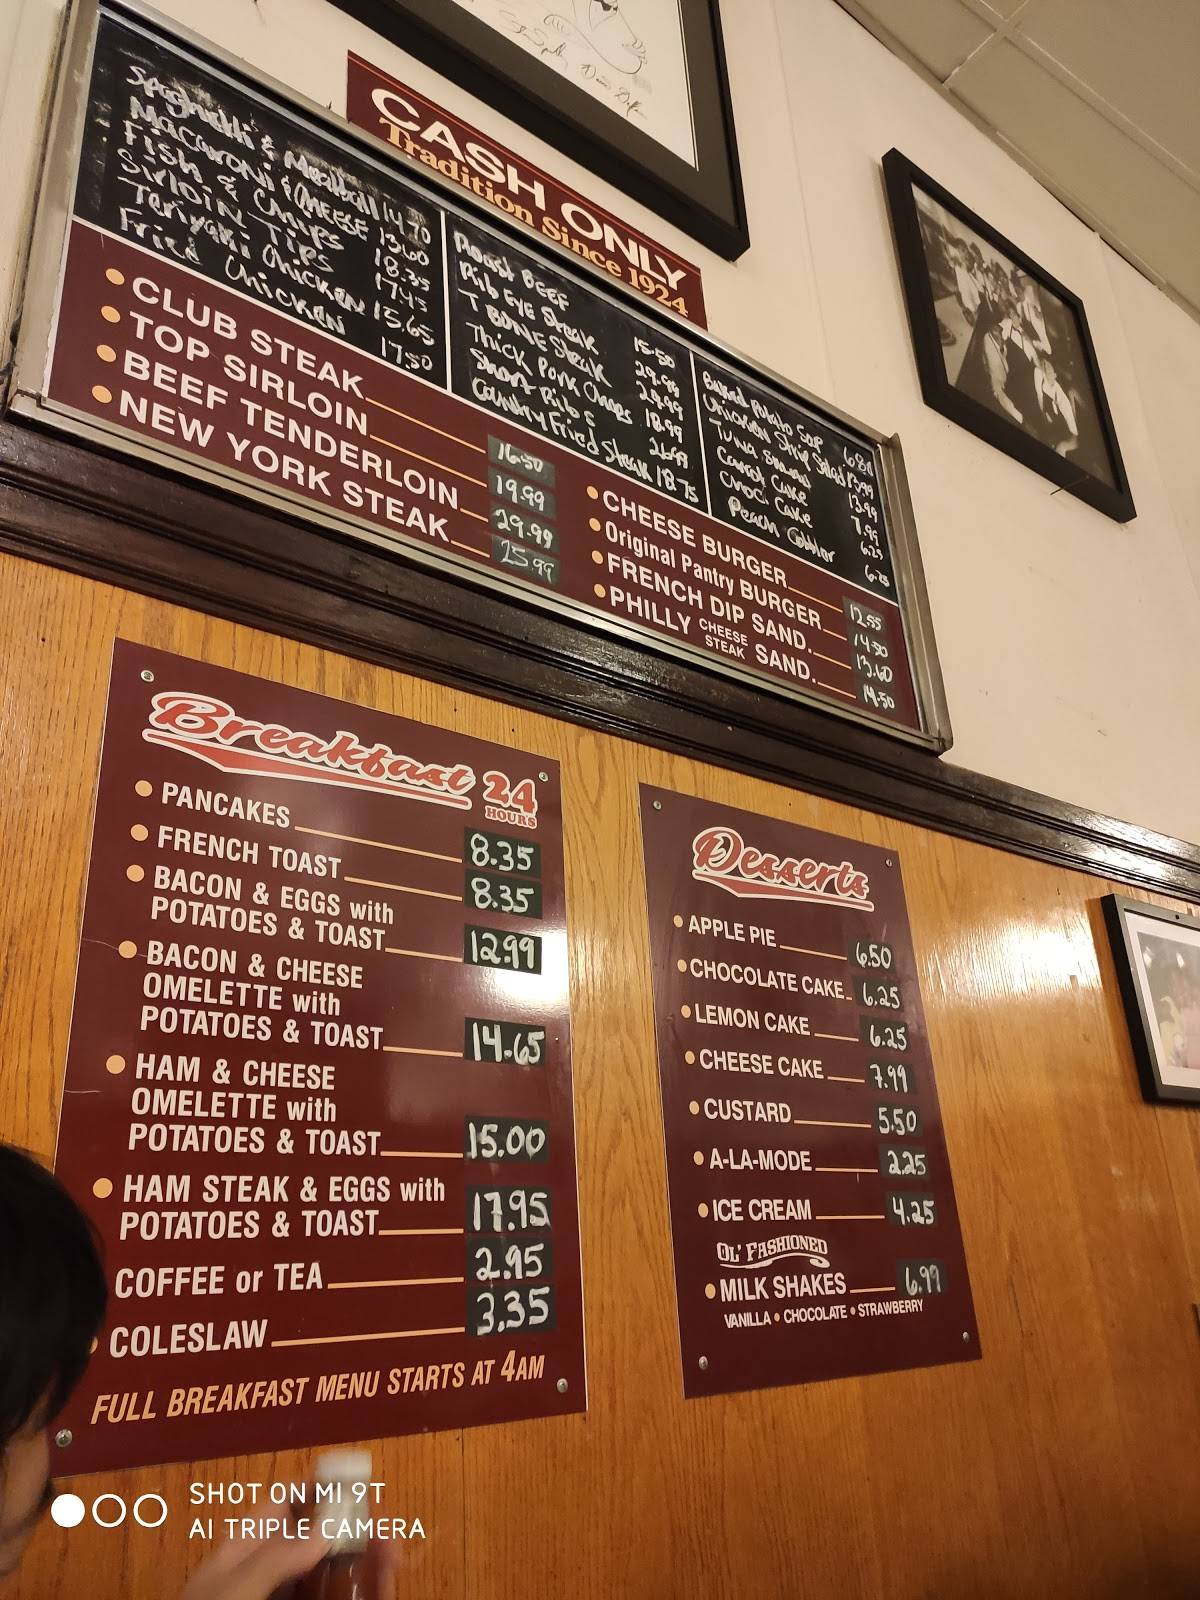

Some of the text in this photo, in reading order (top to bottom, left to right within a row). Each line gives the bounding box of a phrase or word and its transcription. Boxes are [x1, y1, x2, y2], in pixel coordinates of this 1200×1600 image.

[261, 135, 276, 161] &
[122, 120, 204, 184] Fish
[375, 248, 430, 292] 18.35
[371, 88, 546, 211] CASH
[560, 202, 687, 291] ONLY
[379, 117, 690, 319] Tradition Since 1924
[459, 261, 499, 300] Rib
[457, 288, 479, 313] T
[132, 276, 365, 399] CLUB STEAK
[374, 300, 435, 346] 15.65
[382, 336, 432, 371] 17.50
[633, 336, 675, 369] 15.50
[129, 311, 367, 437] TOP SIRLOIN
[123, 349, 459, 510] BEEF TENDERLOIN
[550, 412, 599, 456] Fried
[119, 389, 451, 543] NEW YORK STEAK
[497, 442, 544, 473] 16.50
[496, 474, 545, 512] 19.99
[495, 508, 553, 549] 29.99
[603, 490, 787, 589] CHEESE BURGER
[500, 539, 555, 584] 25.99
[605, 520, 823, 631] Original Pantry BURGER
[607, 552, 813, 654] FRENCH DIP SAND.
[849, 603, 882, 632] 12.55
[610, 585, 817, 684] PHILLY CHEESE STEAK SAND.
[856, 654, 893, 683] 13.60
[148, 691, 538, 817] Breakfast 24
[162, 781, 290, 829] PANCAKES
[484, 806, 537, 829] HOURS
[157, 825, 341, 879] FRENCH TOAST
[470, 833, 533, 871] 8.35
[693, 826, 869, 899] Desserts
[154, 866, 394, 925] BACON & EGGS with
[470, 877, 534, 913] 8.35
[151, 896, 386, 951] POTATOES & TOAST
[688, 915, 777, 948] APPLE PIE
[146, 940, 363, 989] BACON & CHEESE
[471, 930, 535, 969] 12.99
[855, 942, 892, 969] 6.50
[143, 972, 340, 1016] OMELETTE with
[690, 958, 844, 999] CHOCOLATE CAKE
[862, 982, 900, 1009] 6.25
[140, 1005, 383, 1050] POTATOES & TOAST
[694, 1003, 810, 1036] LEMON CAKE
[869, 1024, 907, 1051] 6.25
[472, 1021, 545, 1066] 14.65
[135, 1053, 335, 1090] HAM & CHEESE
[699, 1049, 824, 1079] CHEESE CAKE
[869, 1064, 908, 1092] 7.99
[130, 1087, 336, 1122] OMELETTE with
[704, 1098, 791, 1123] CUSTARD
[878, 1107, 917, 1135] 5.50
[128, 1123, 381, 1156] POTATOES & TOAST
[468, 1122, 546, 1159] 15.00
[709, 1148, 812, 1171] A-LA-MODE
[888, 1150, 926, 1176] 2.25
[123, 1174, 446, 1202] HAM STEAK & EGGS with
[119, 1209, 379, 1240] POTATOES & TOAST
[472, 1190, 550, 1233] 17.95
[712, 1199, 812, 1221] ICE CREAM
[892, 1197, 935, 1225] 4.25
[115, 1262, 323, 1299] COFFEE or TEA
[474, 1243, 545, 1280] 2.95
[905, 1264, 941, 1296] 6.99
[720, 1272, 847, 1302] MILK SHAKES
[476, 1286, 550, 1336] 3.35
[724, 1299, 924, 1328] VANILLA CHOCOLATE STRAWBERRY
[109, 1319, 268, 1358] COLESLAW
[91, 1350, 545, 1425] FULL BREAKFAST MENU STARTS AT 4AM
